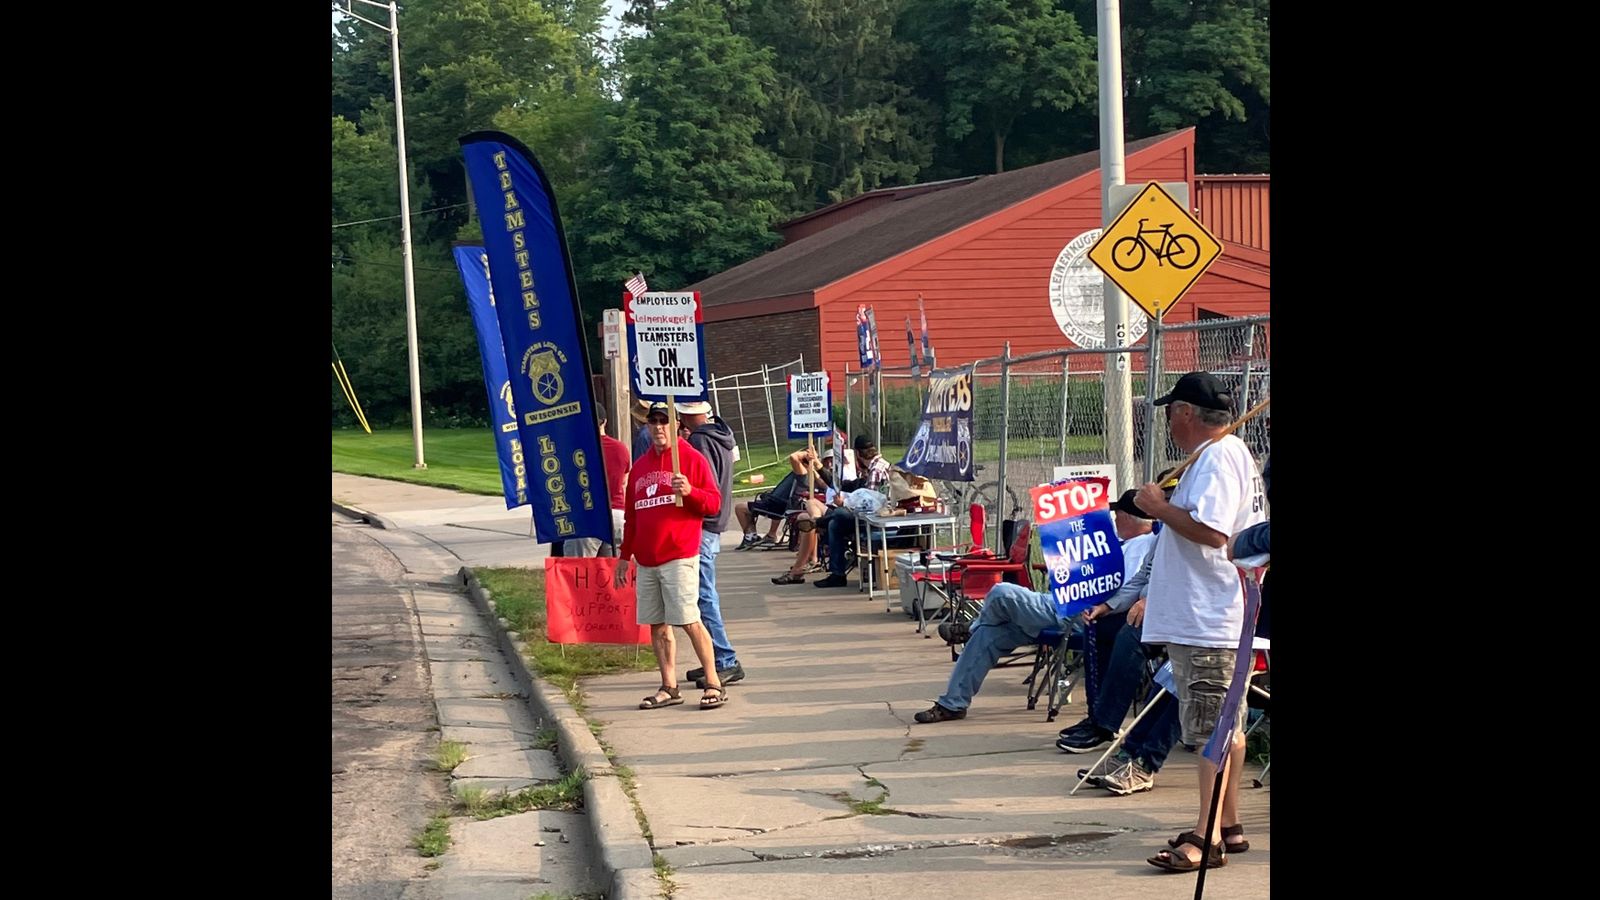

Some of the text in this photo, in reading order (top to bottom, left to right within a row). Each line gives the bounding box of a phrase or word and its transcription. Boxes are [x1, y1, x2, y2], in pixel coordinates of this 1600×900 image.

[494, 151, 541, 330] TEAMSTERS
[636, 296, 691, 306] EMPLOYEES OF
[638, 332, 695, 342] TEAMSTERS
[1116, 323, 1126, 362] HOFA
[658, 348, 678, 367] ON
[644, 367, 695, 388] STRIKE
[796, 377, 823, 393] DISPUTE
[529, 404, 579, 421] WISCONSIN
[794, 421, 827, 429] TEAMSTERS
[538, 436, 593, 536] LOCAL 662
[1038, 482, 1104, 520] STOP
[1069, 518, 1086, 533] THE
[1056, 530, 1111, 563] WAR
[1081, 563, 1094, 577] ON
[596, 592, 612, 602] TO
[1055, 572, 1121, 604] WORKERS
